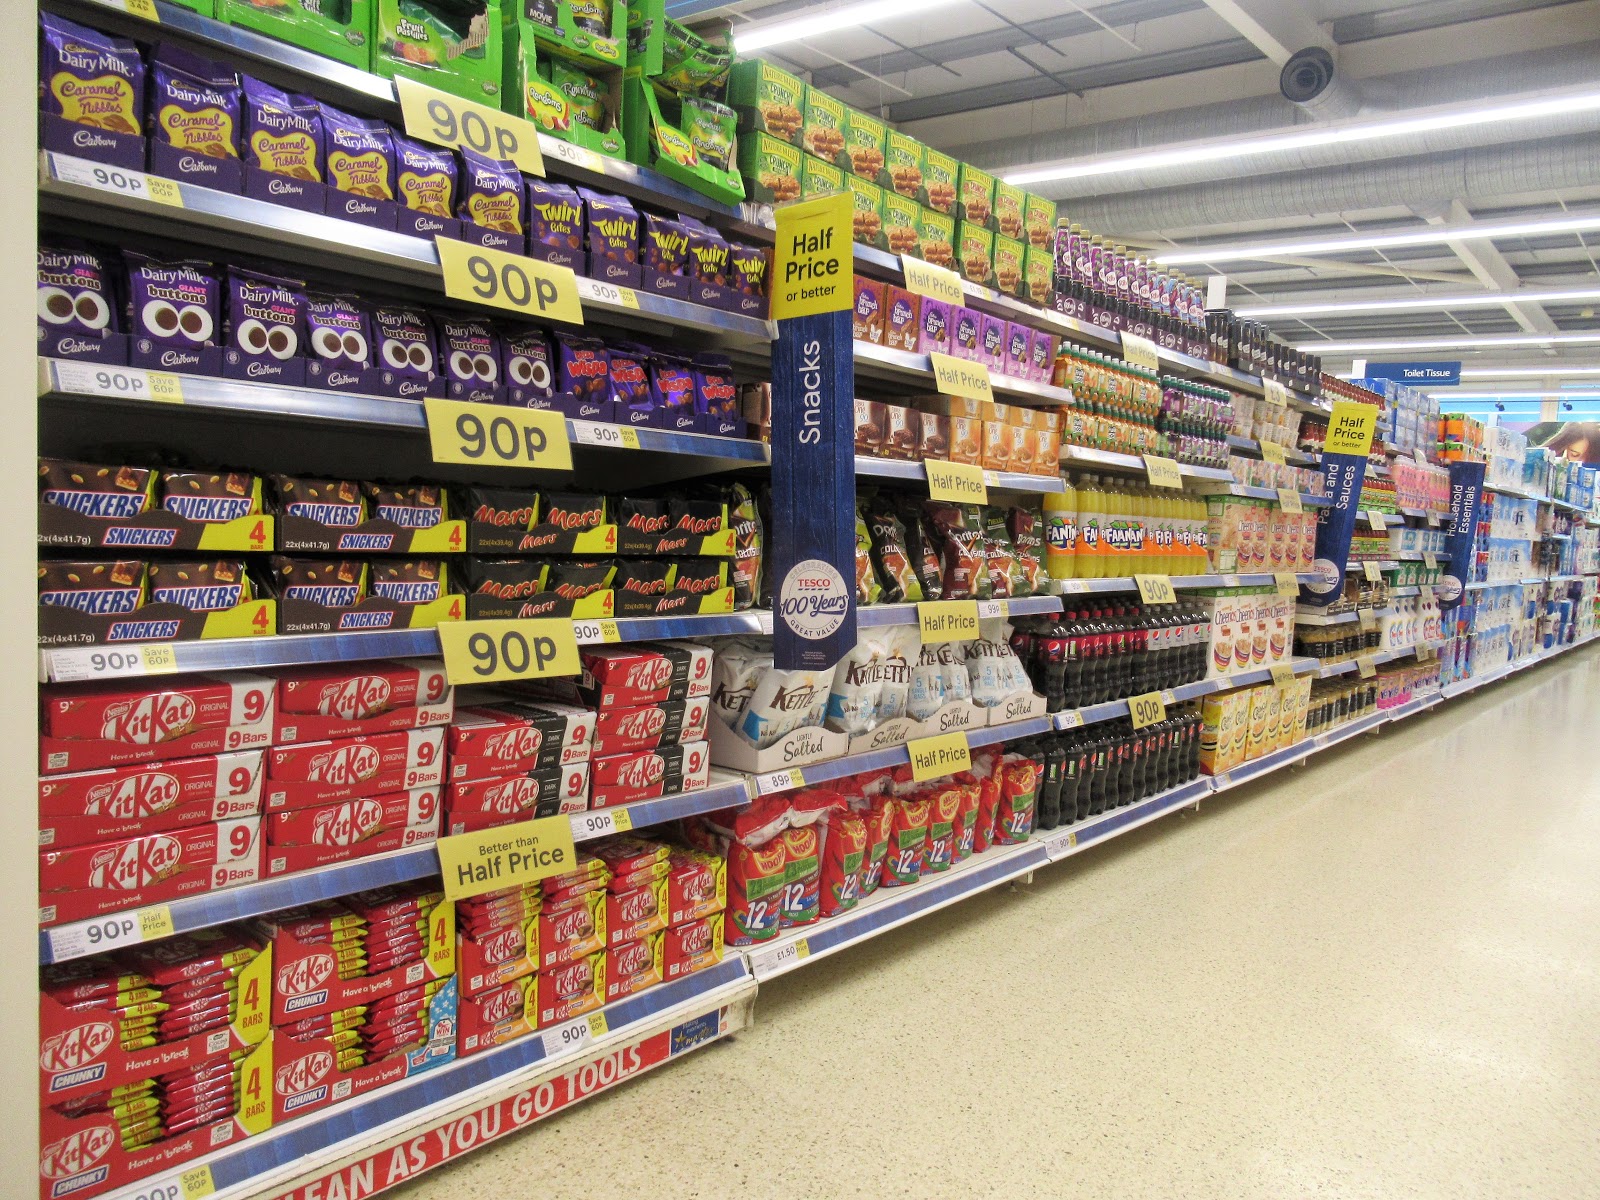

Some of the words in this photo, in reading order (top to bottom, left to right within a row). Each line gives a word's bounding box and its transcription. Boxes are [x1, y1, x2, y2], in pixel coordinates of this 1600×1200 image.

[59, 51, 97, 70] Dairy
[61, 80, 126, 97] Caramel
[167, 86, 200, 105] Dairy
[80, 99, 122, 114] Nibbles
[168, 113, 225, 128] Caramel
[258, 111, 287, 130] Dairy
[427, 99, 519, 160] 90p
[74, 130, 117, 149] Cadbury
[184, 131, 223, 144] Nibbles
[259, 137, 310, 153] Caramel
[179, 157, 217, 173] Cadbury
[273, 155, 307, 167] Nibbles
[93, 168, 142, 192] 90p
[147, 178, 173, 190] Save
[269, 180, 303, 196] Cadbury
[152, 187, 173, 199] 60p
[533, 201, 581, 227] Twirl
[550, 224, 571, 235] Bites
[592, 216, 637, 240] Twirl
[793, 227, 833, 257] Half
[141, 267, 176, 284] Dairy
[786, 258, 839, 282] Price
[179, 284, 207, 294] GIANT
[467, 256, 558, 311] 90p
[591, 284, 618, 299] 90p
[909, 270, 930, 288] Half
[933, 277, 960, 298] Price
[147, 284, 207, 305] buttons
[239, 286, 270, 304] Dairy
[786, 292, 797, 301] or
[802, 286, 835, 299] better
[244, 304, 295, 324] buttons
[58, 338, 100, 354] Cadbury
[567, 361, 607, 377] Wispa
[1403, 369, 1424, 377] Toilet
[1426, 369, 1450, 377] Tissue
[95, 372, 143, 391] 90p
[150, 375, 174, 386] Save
[939, 368, 959, 383] Half
[962, 372, 987, 390] Price
[154, 384, 174, 394] 60p
[799, 340, 821, 444] Snacks
[1340, 416, 1364, 427] Half
[455, 413, 547, 461] 90p
[593, 427, 618, 441] 90p
[1333, 427, 1365, 440] Price
[1342, 441, 1361, 449] better
[933, 474, 953, 490] Half
[956, 477, 982, 493] Price
[1326, 463, 1339, 490] and
[1336, 465, 1355, 510] Sauces
[165, 498, 250, 520] SNICKERS
[547, 508, 600, 529] Mars
[1446, 484, 1463, 537] Household
[1458, 486, 1476, 534] Essentials
[106, 528, 176, 545] SNICKERS
[250, 521, 266, 543] 4
[519, 534, 556, 549] Mars
[726, 533, 734, 548] 4
[341, 535, 392, 549] SNICKERS
[798, 579, 830, 587] TESCO
[1144, 579, 1168, 600] 90p
[781, 597, 809, 617] 100
[810, 594, 849, 617] Years
[109, 622, 178, 639] SNICKERS
[575, 625, 599, 639] 90p
[790, 619, 813, 637] GREAT
[816, 618, 839, 637] VALUE
[924, 615, 946, 631] Half
[948, 615, 975, 629] Price
[91, 652, 138, 671] 90p
[144, 647, 169, 657] Save
[148, 656, 169, 666] 60p
[468, 631, 557, 675] 90p
[695, 657, 706, 676] 9
[427, 674, 443, 700] 9
[200, 701, 229, 713] ORIGINAL
[244, 689, 265, 720] 9
[326, 676, 387, 719] KitKat
[113, 694, 190, 744] KitKat
[1006, 702, 1031, 718] Salted
[1136, 702, 1158, 723] 90p
[940, 711, 969, 731] Salted
[191, 739, 220, 750] ORIGINAL
[871, 727, 907, 748] Salted
[784, 738, 822, 762] Salted
[915, 753, 938, 770] Half
[940, 747, 966, 764] Price
[772, 775, 789, 787] 89p
[586, 817, 610, 831] 90p
[479, 841, 513, 855] Better
[516, 836, 538, 847] than
[102, 836, 179, 889] KitKat
[458, 860, 504, 885] Half
[509, 848, 564, 874] Price
[898, 850, 912, 873] 12
[841, 875, 857, 900] 12
[785, 884, 804, 911] 12
[143, 912, 162, 923] Half
[746, 901, 767, 929] 12
[87, 919, 133, 944] 90p
[142, 919, 166, 931] Price
[777, 947, 795, 960] £1.50
[284, 955, 331, 993] KitKat
[244, 978, 259, 1011] 4
[287, 992, 326, 1010] CHUNKY
[343, 987, 361, 997] Have
[243, 1012, 263, 1028] BARS
[562, 1023, 586, 1043] 90p
[49, 1024, 110, 1070] KitKat
[126, 1057, 151, 1071] Have
[283, 1053, 330, 1093] KitKat
[53, 1066, 102, 1089] CHUNKY
[247, 1067, 261, 1100] 4
[286, 1090, 325, 1109] CHUNKY
[246, 1103, 265, 1117] BARS
[387, 1137, 426, 1184] AS
[436, 1104, 500, 1161] YOU
[512, 1083, 553, 1124] GO
[563, 1044, 642, 1098] TOOLS
[49, 1128, 110, 1177] KitKat
[55, 1168, 106, 1195] CHUNKY
[183, 1170, 206, 1182] Save
[135, 1184, 178, 1200] 0p
[188, 1180, 206, 1192] 60p
